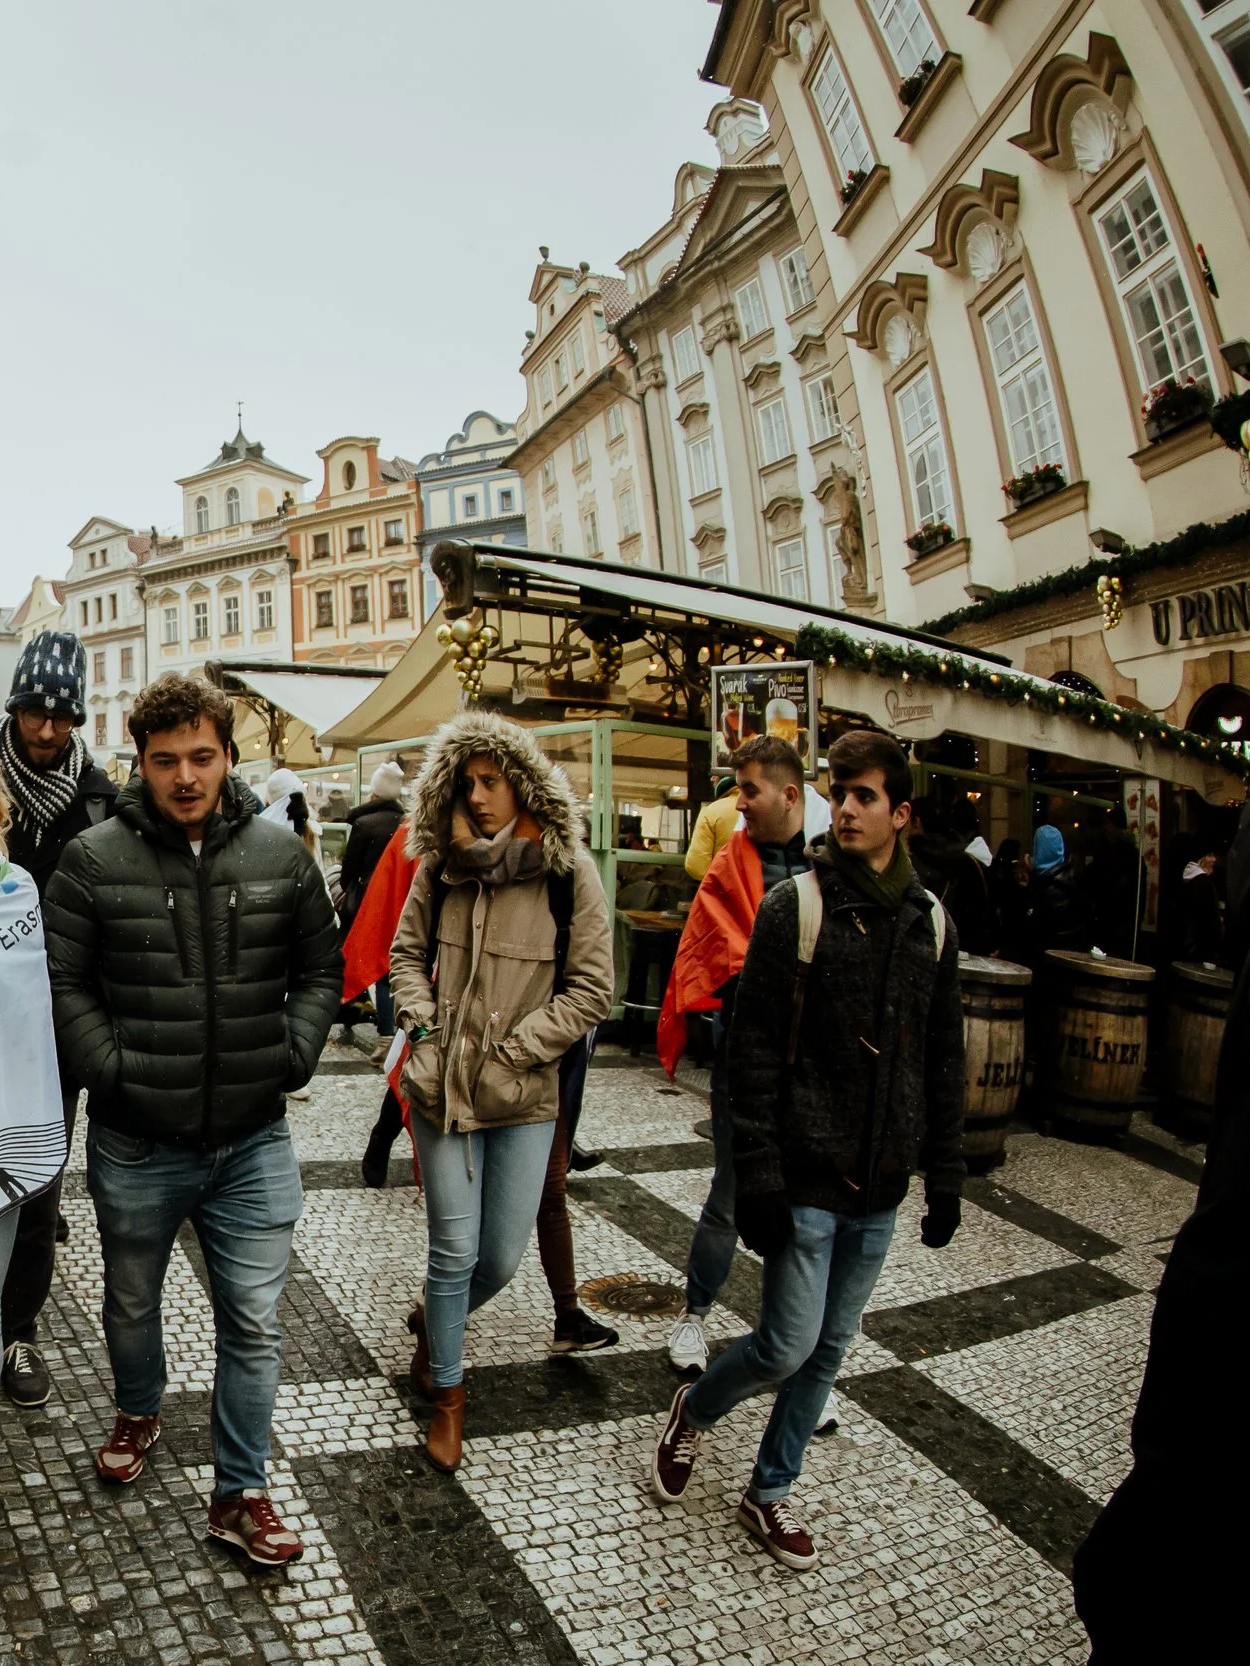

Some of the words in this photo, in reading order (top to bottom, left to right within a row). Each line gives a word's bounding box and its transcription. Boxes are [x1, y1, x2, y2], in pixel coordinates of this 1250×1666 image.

[1148, 599, 1171, 646] U
[1175, 581, 1250, 641] PRIN
[719, 674, 748, 694] Svařák
[768, 678, 787, 698] Pivo
